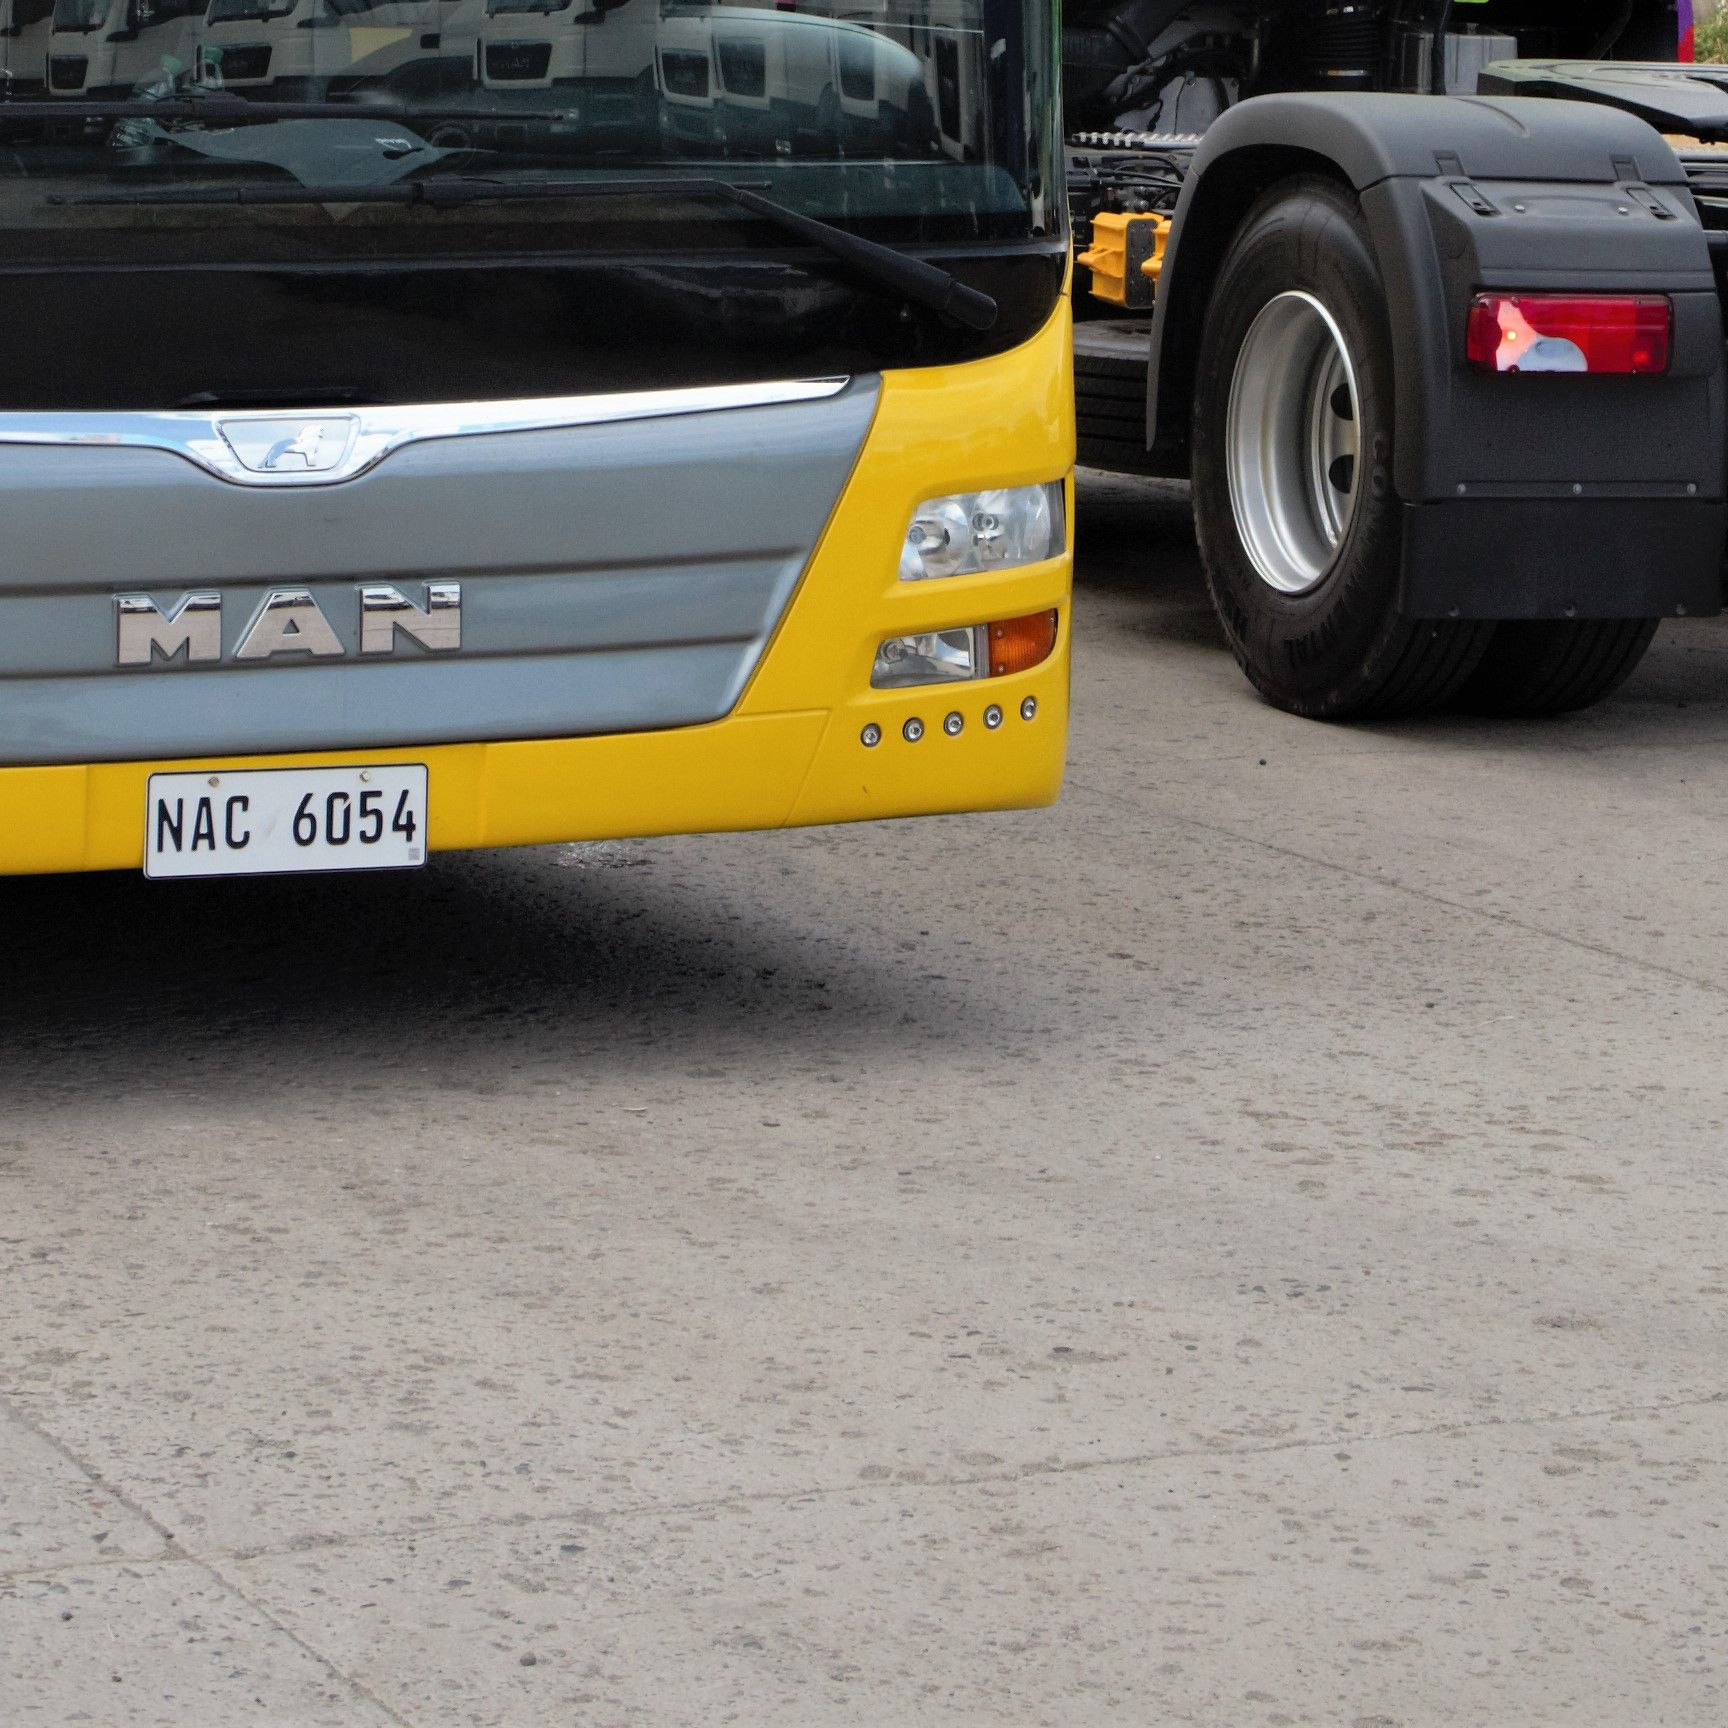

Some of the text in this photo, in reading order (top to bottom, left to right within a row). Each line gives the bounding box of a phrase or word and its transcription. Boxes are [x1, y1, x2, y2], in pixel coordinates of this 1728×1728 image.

[112, 579, 464, 666] MAN
[157, 789, 417, 853] NAC 6054
